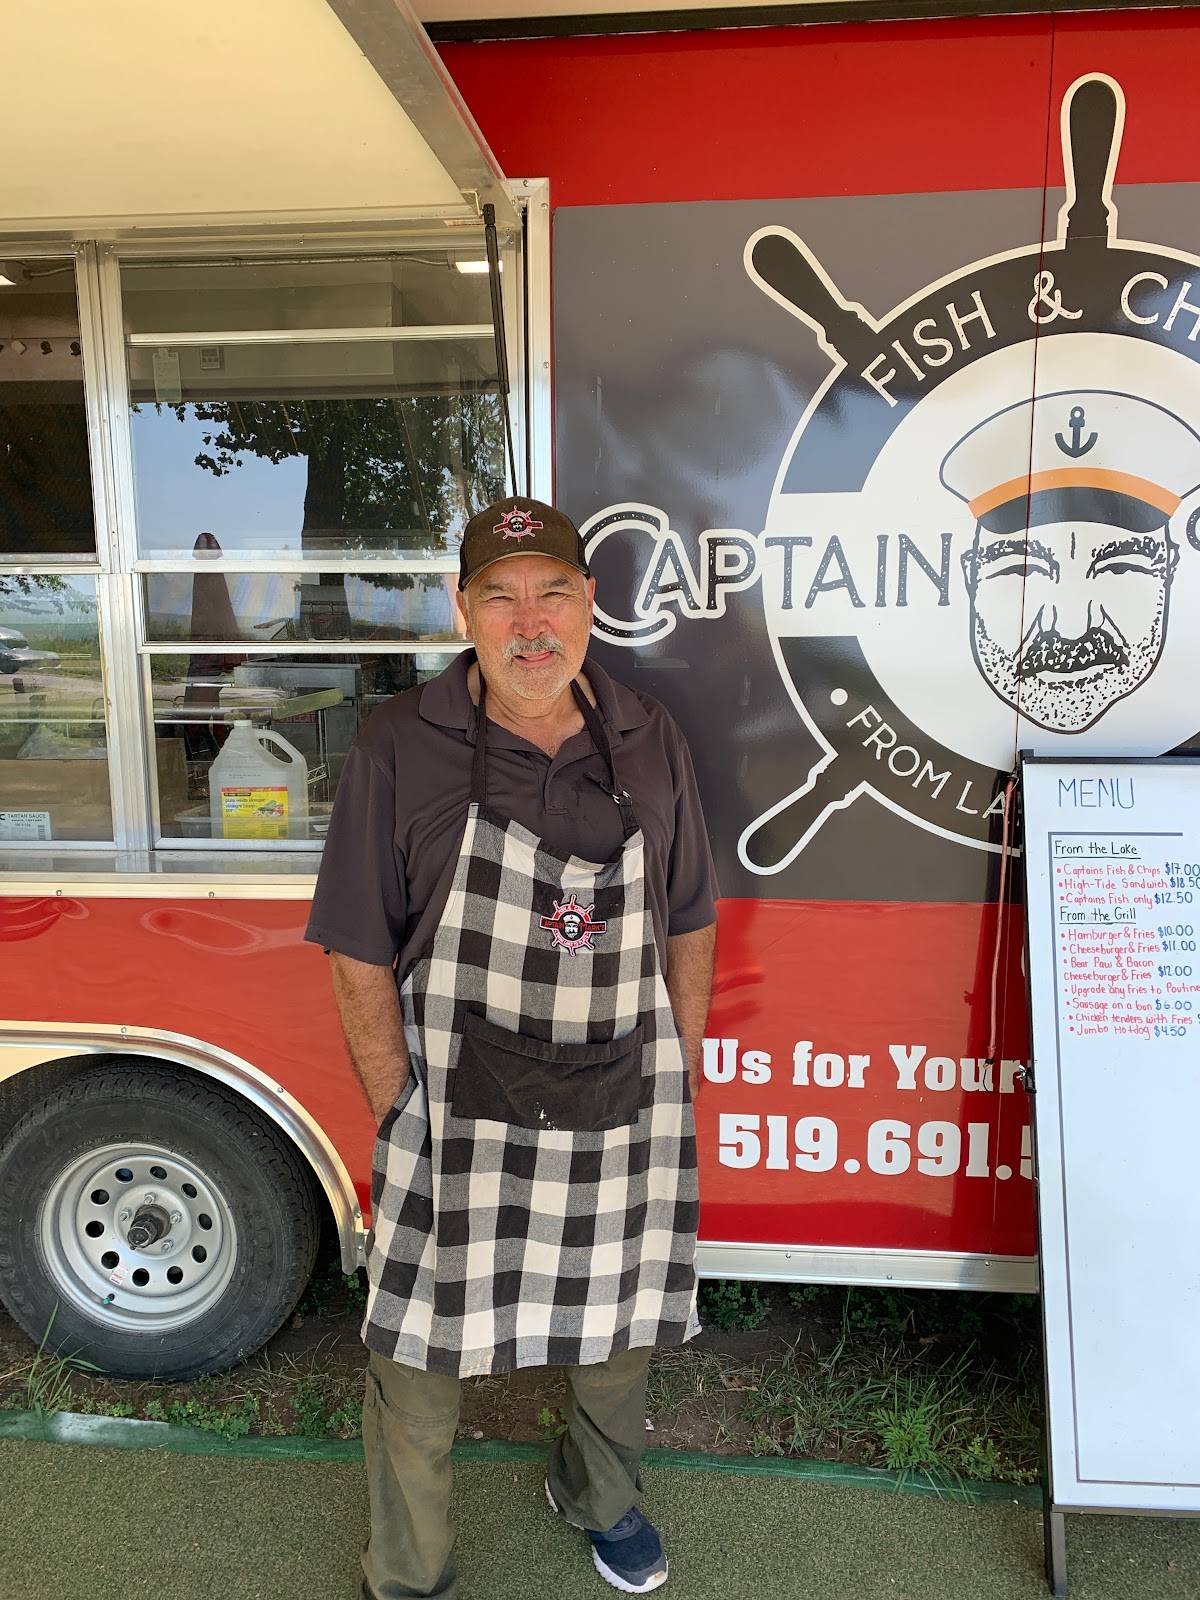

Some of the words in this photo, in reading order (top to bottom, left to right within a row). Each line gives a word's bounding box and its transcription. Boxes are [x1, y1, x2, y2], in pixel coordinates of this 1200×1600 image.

[860, 290, 997, 407] FISH
[1027, 270, 1083, 325] &
[581, 508, 953, 641] CAPTAIN
[846, 705, 952, 799] FROM
[956, 780, 1019, 826] LA
[1058, 778, 1135, 809] MENU
[1055, 840, 1083, 854] From
[1088, 842, 1108, 854] the
[1111, 842, 1138, 855] Lake
[1063, 863, 1103, 878] Captains
[1106, 864, 1126, 875] Fish
[1128, 864, 1134, 874] &
[1136, 864, 1160, 878] Chips
[1165, 862, 1200, 876] $17.00
[1064, 879, 1116, 895] High-Tide
[1122, 878, 1168, 889] Sandwich
[1066, 893, 1106, 906] Captains
[1108, 893, 1130, 904] Fish
[1134, 896, 1152, 910] only
[1154, 892, 1193, 904] $12.50
[1060, 906, 1086, 921] From
[1091, 908, 1110, 921] the
[1114, 906, 1136, 920] Grill
[1134, 928, 1156, 940] Fries
[1158, 924, 1194, 938] $10.00
[1138, 943, 1160, 953] Fries
[1162, 940, 1197, 952] $11.00
[1071, 956, 1088, 968] Bear
[1094, 956, 1112, 968] Paw
[1126, 956, 1154, 968] Bacon
[1131, 970, 1152, 980] Fries
[1158, 966, 1192, 978] $12.00
[1071, 984, 1106, 998] Upgrade
[1150, 984, 1162, 994] to
[1072, 998, 1108, 1015] Sausage
[1136, 1000, 1152, 1010] bun
[1111, 1014, 1143, 1024] tenders
[1146, 1014, 1168, 1024] with
[1172, 1014, 1192, 1024] Fries
[1077, 1024, 1108, 1036] Jumbo
[702, 1038, 772, 1085] Us
[792, 1040, 870, 1089] for
[888, 1044, 1021, 1094] Your
[719, 1113, 1033, 1181] 519.691.
